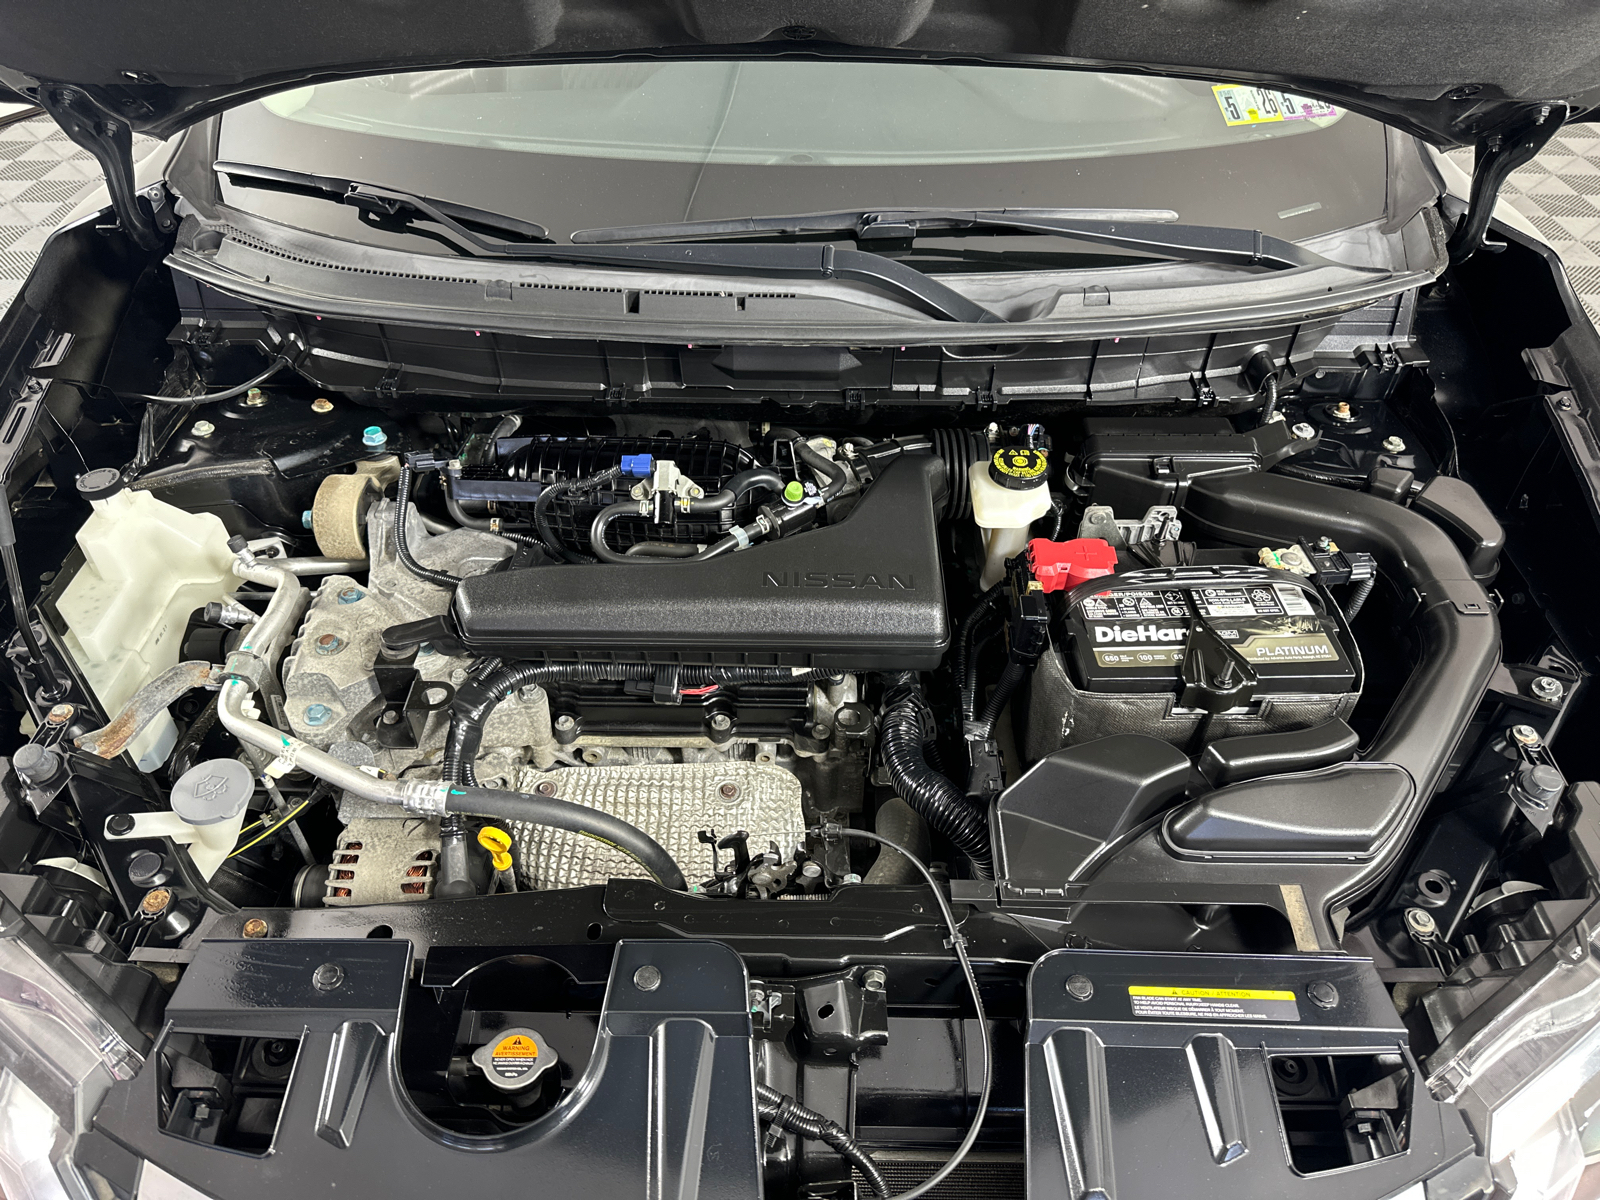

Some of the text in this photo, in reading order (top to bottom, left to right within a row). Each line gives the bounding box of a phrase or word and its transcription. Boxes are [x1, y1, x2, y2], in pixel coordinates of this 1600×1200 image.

[1225, 96, 1241, 120] 5
[761, 571, 916, 591] NISSAN
[1094, 625, 1189, 642] DieHar
[1256, 645, 1328, 656] PLATINUM
